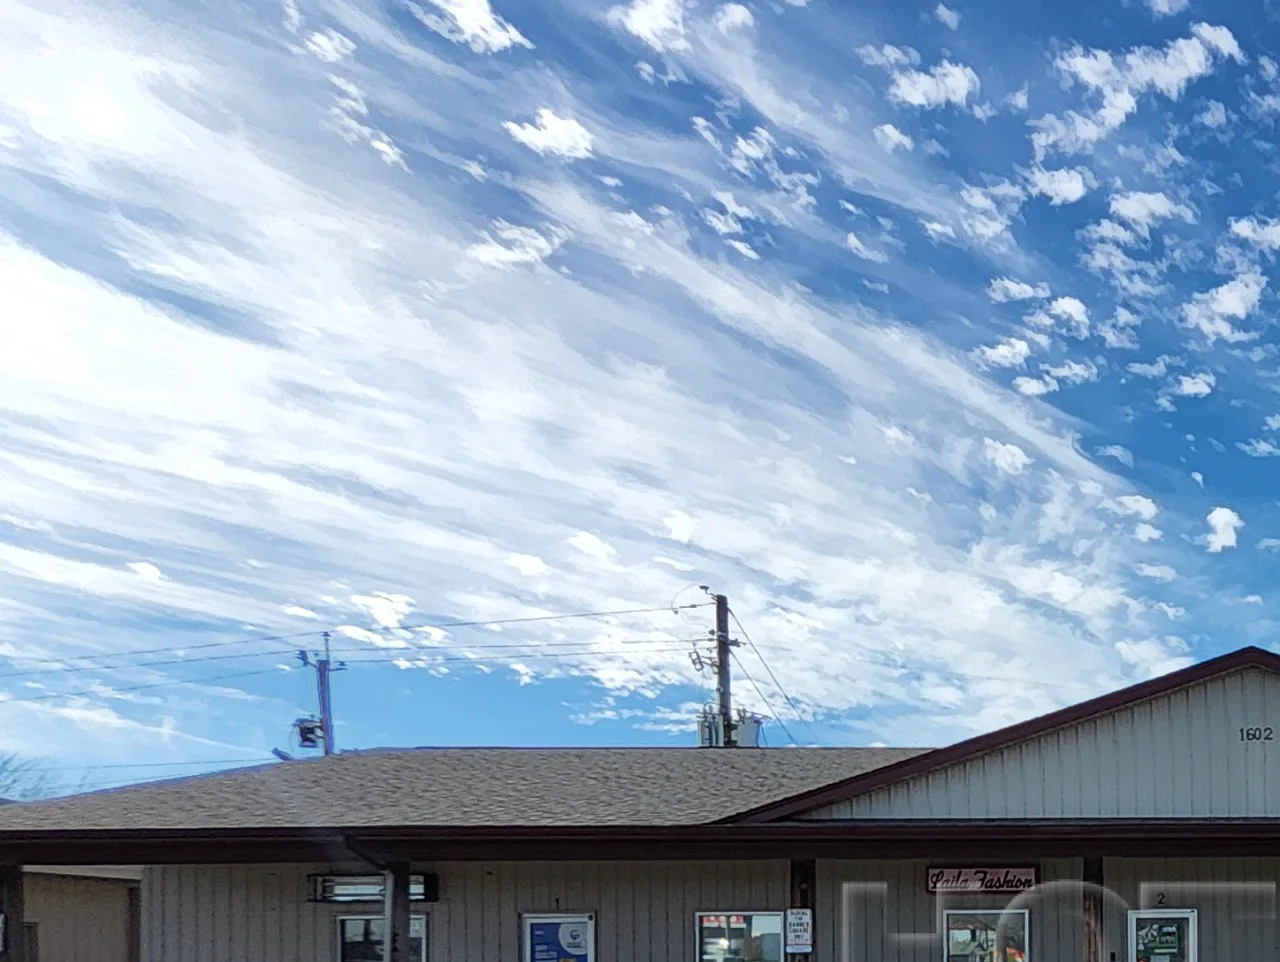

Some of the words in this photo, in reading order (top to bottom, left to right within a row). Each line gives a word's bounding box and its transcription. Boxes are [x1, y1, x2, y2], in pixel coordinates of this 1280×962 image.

[1239, 727, 1273, 741] 1602
[930, 870, 969, 889] Laila
[973, 869, 1033, 889] Fashion
[1156, 892, 1165, 905] 2
